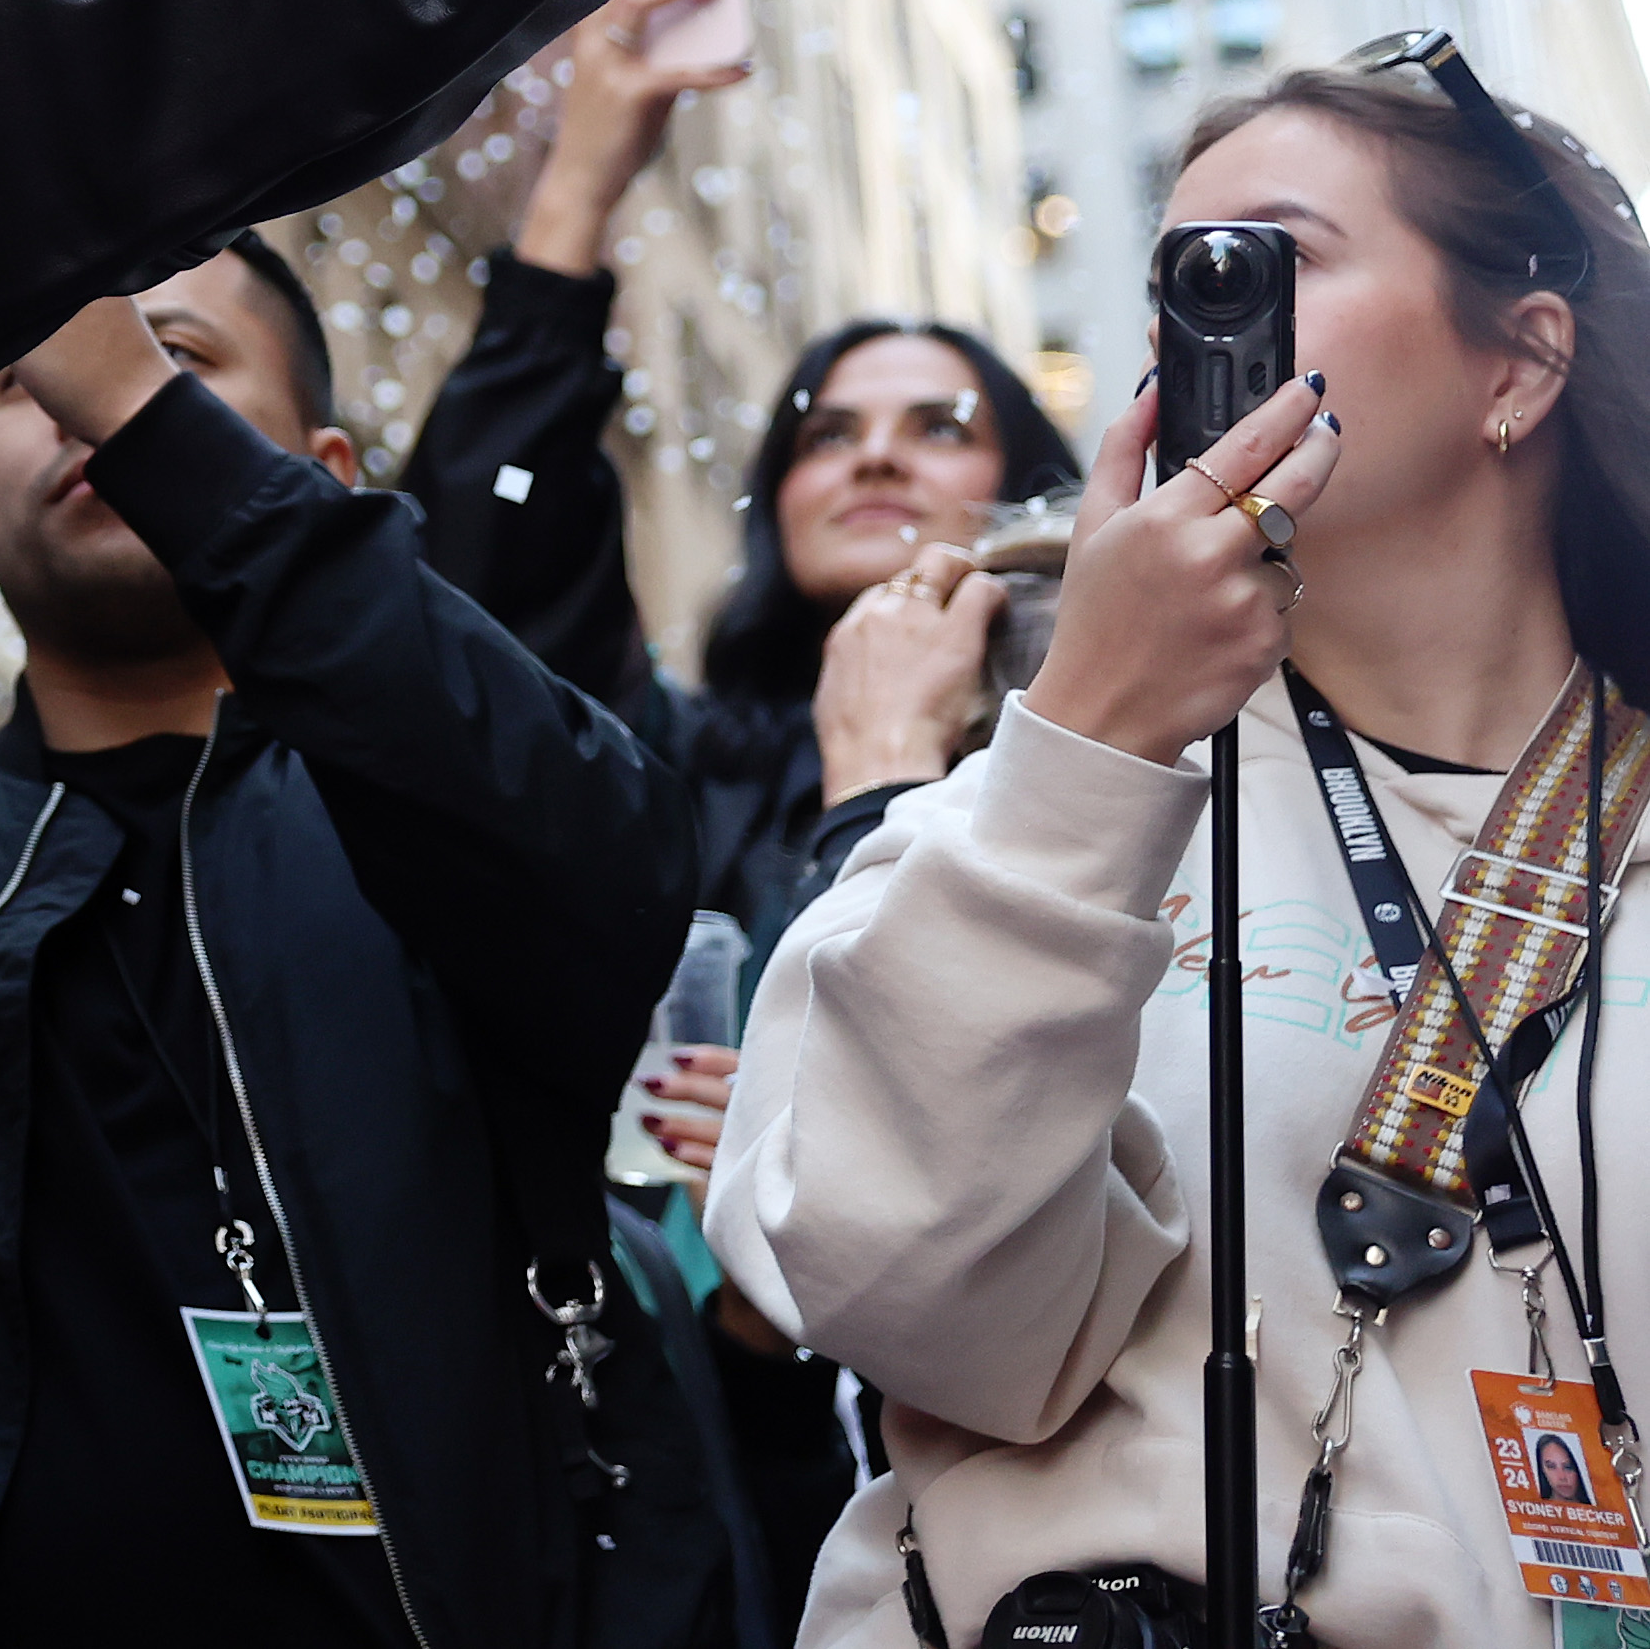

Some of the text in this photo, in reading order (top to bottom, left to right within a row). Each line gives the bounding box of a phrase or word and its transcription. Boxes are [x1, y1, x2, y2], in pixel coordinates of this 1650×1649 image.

[1320, 766, 1388, 863] BROOKLYN
[1419, 1070, 1472, 1097] Nikon
[1495, 1437, 1522, 1460] 23
[1502, 1467, 1531, 1490] 24
[1505, 1499, 1627, 1527] SYDNEY BECKER
[1091, 1575, 1140, 1592] kon
[1012, 1624, 1079, 1644] Nikon
